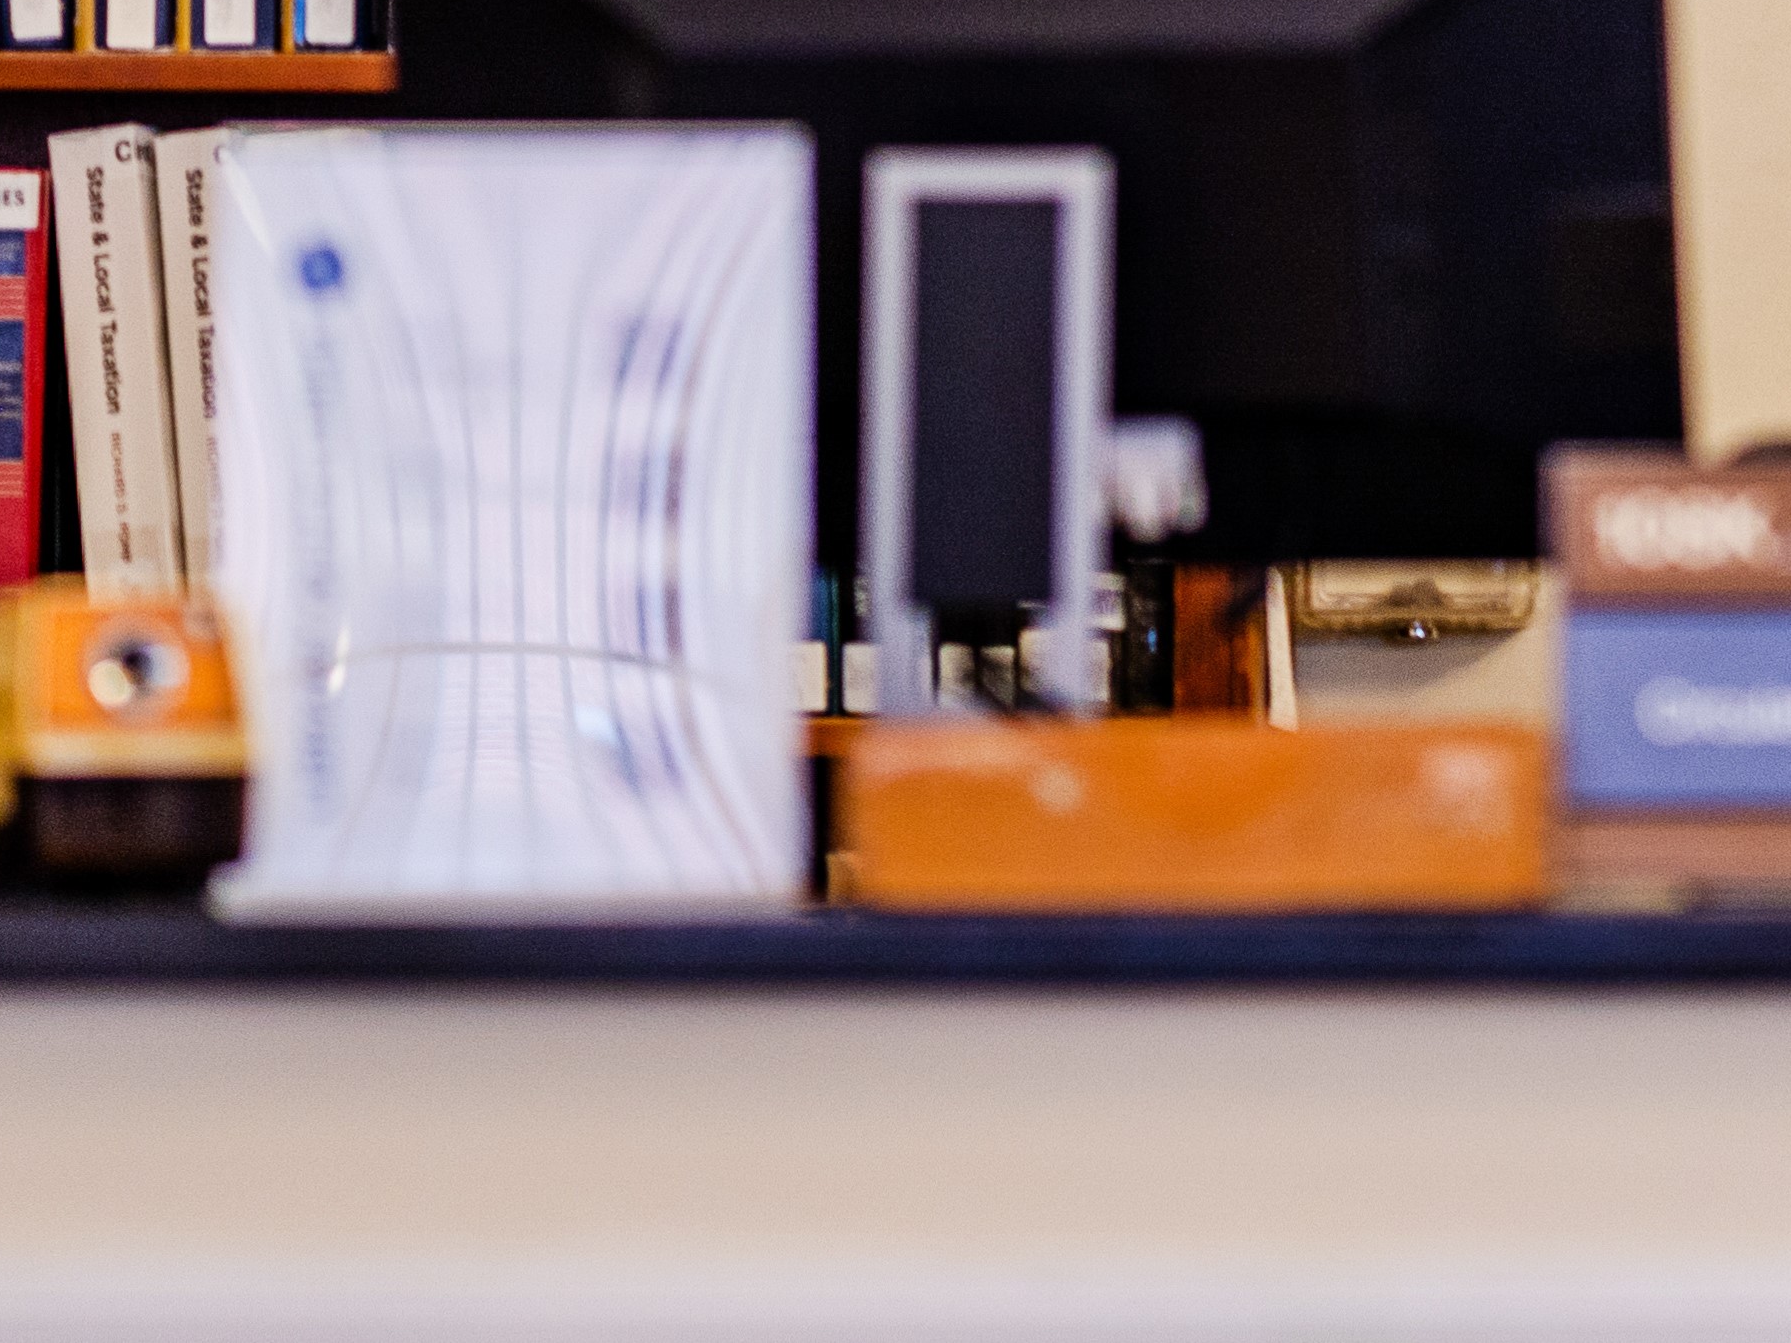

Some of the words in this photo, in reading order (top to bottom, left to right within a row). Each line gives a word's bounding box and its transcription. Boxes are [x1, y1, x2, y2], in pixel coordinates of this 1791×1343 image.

[87, 166, 106, 224] State
[185, 168, 205, 227] State
[92, 231, 109, 246] &
[191, 233, 209, 249] &
[94, 254, 114, 313] Local
[192, 256, 213, 316] Local
[100, 320, 122, 414] Taxation
[197, 325, 219, 419] Taxation
